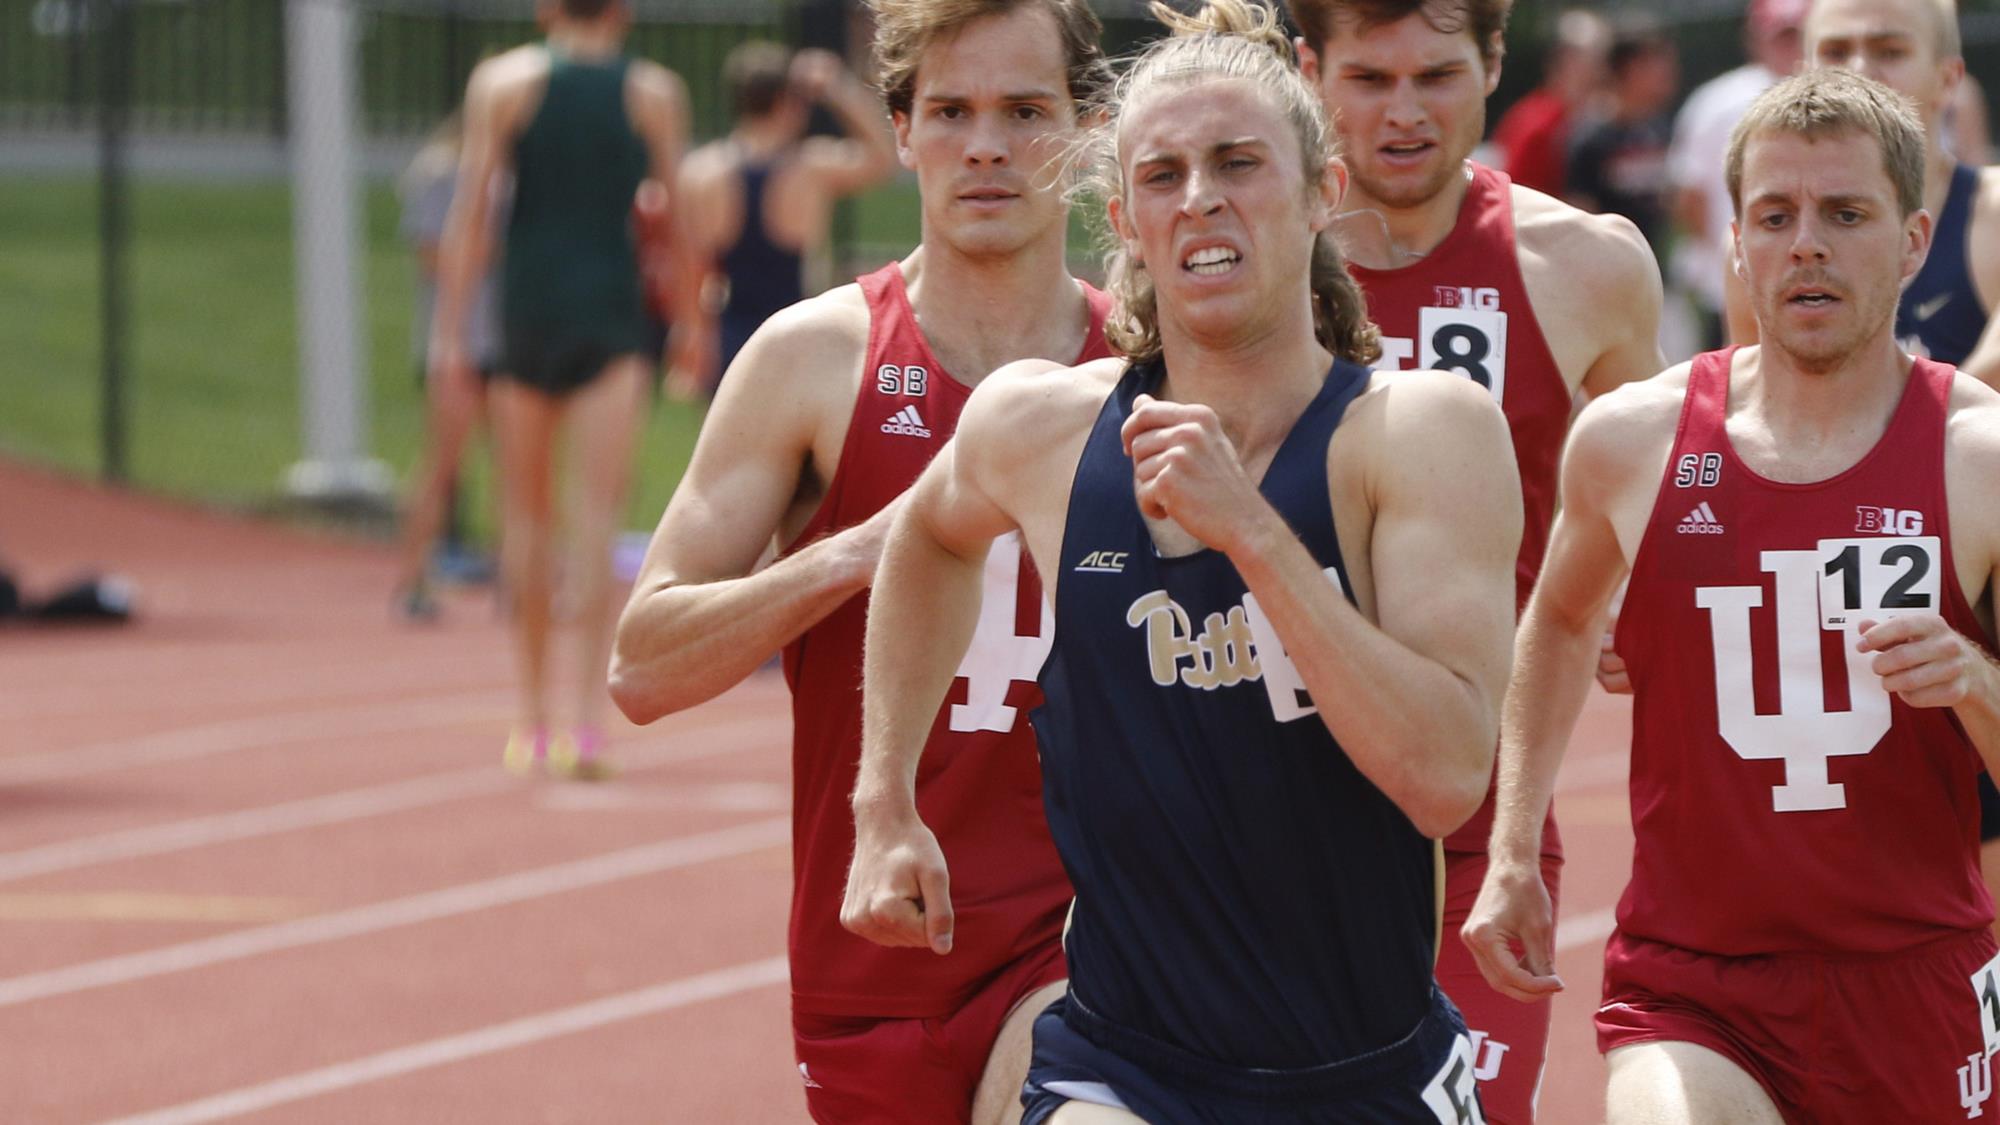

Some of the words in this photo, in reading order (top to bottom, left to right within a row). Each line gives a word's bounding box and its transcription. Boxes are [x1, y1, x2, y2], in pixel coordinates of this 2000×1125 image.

[1431, 323, 1491, 392] 8
[877, 364, 927, 396] SB
[880, 423, 932, 439] adidas
[1675, 452, 1723, 488] SB
[1677, 521, 1724, 535] adidas
[1079, 551, 1129, 569] ACC
[1825, 544, 1931, 610] 12
